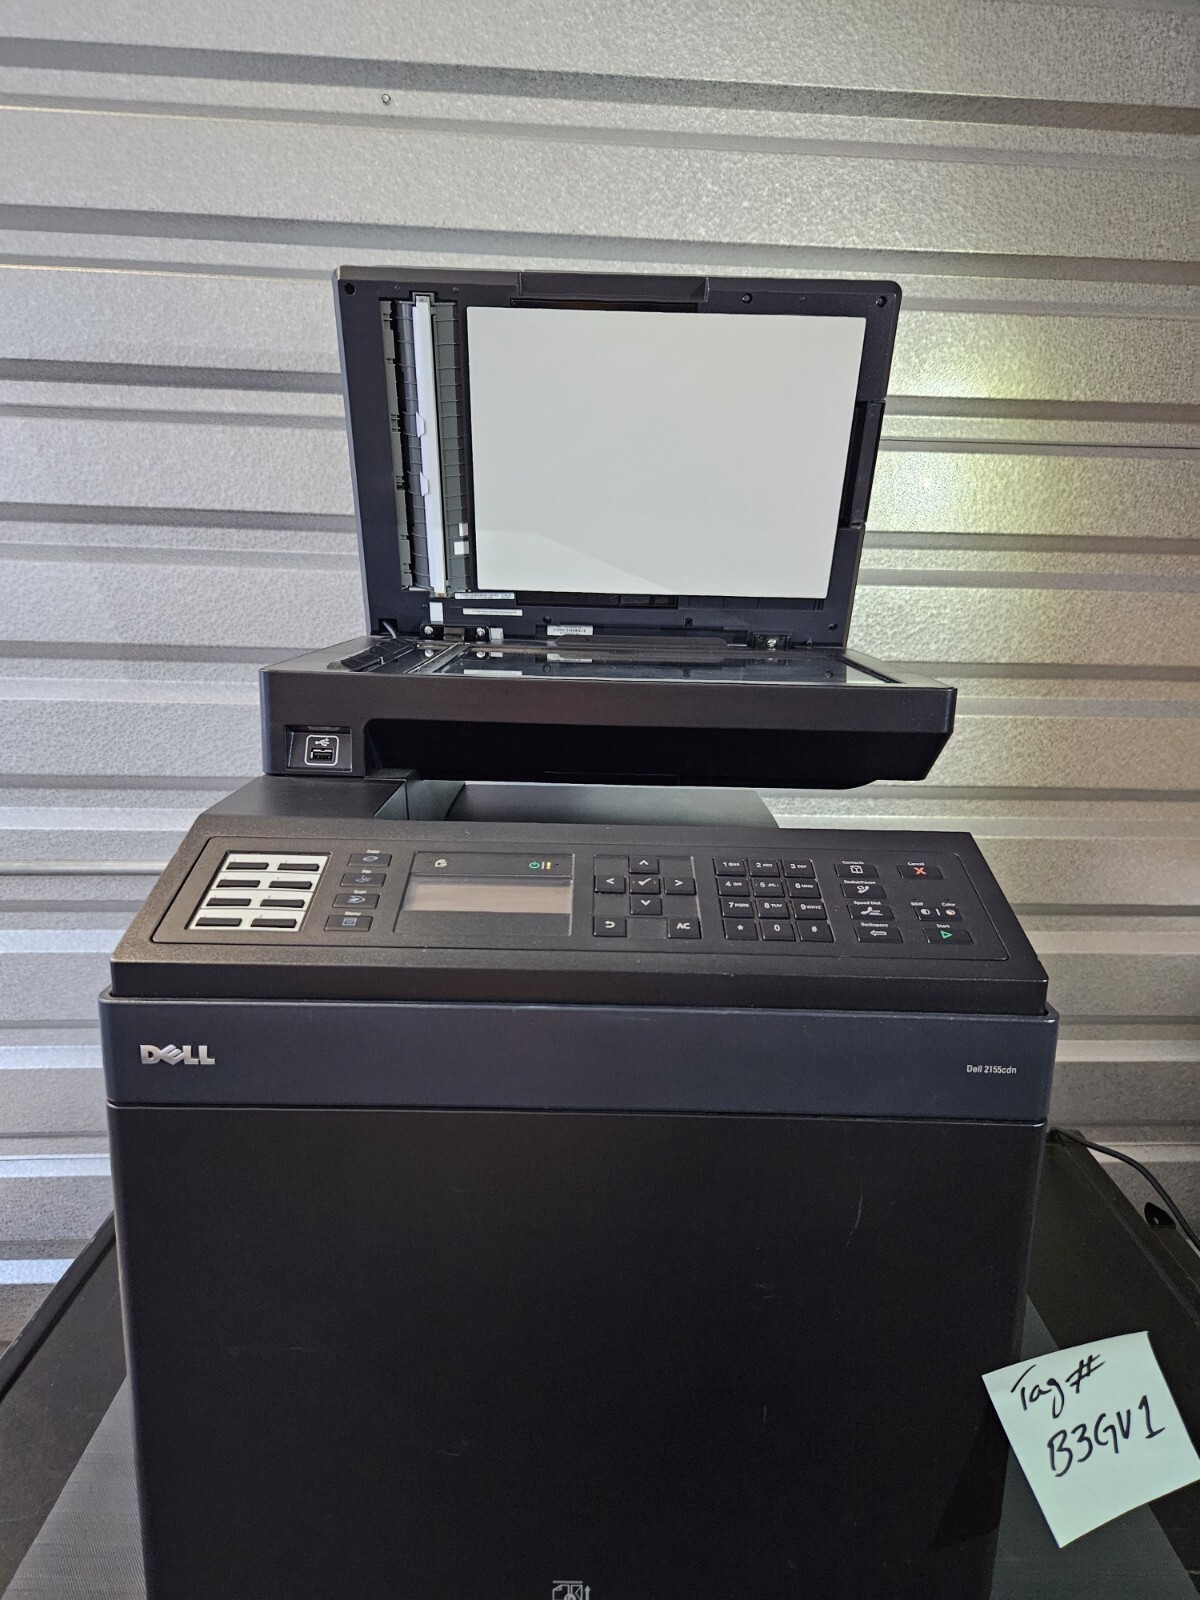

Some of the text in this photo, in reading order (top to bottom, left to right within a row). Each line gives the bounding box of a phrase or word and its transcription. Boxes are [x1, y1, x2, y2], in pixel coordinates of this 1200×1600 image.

[676, 922, 691, 930] AC
[773, 924, 781, 932] 0
[139, 1043, 216, 1066] DELL
[966, 1064, 1017, 1074] Dell 2155cdn
[1046, 1394, 1166, 1478] B3GV1
